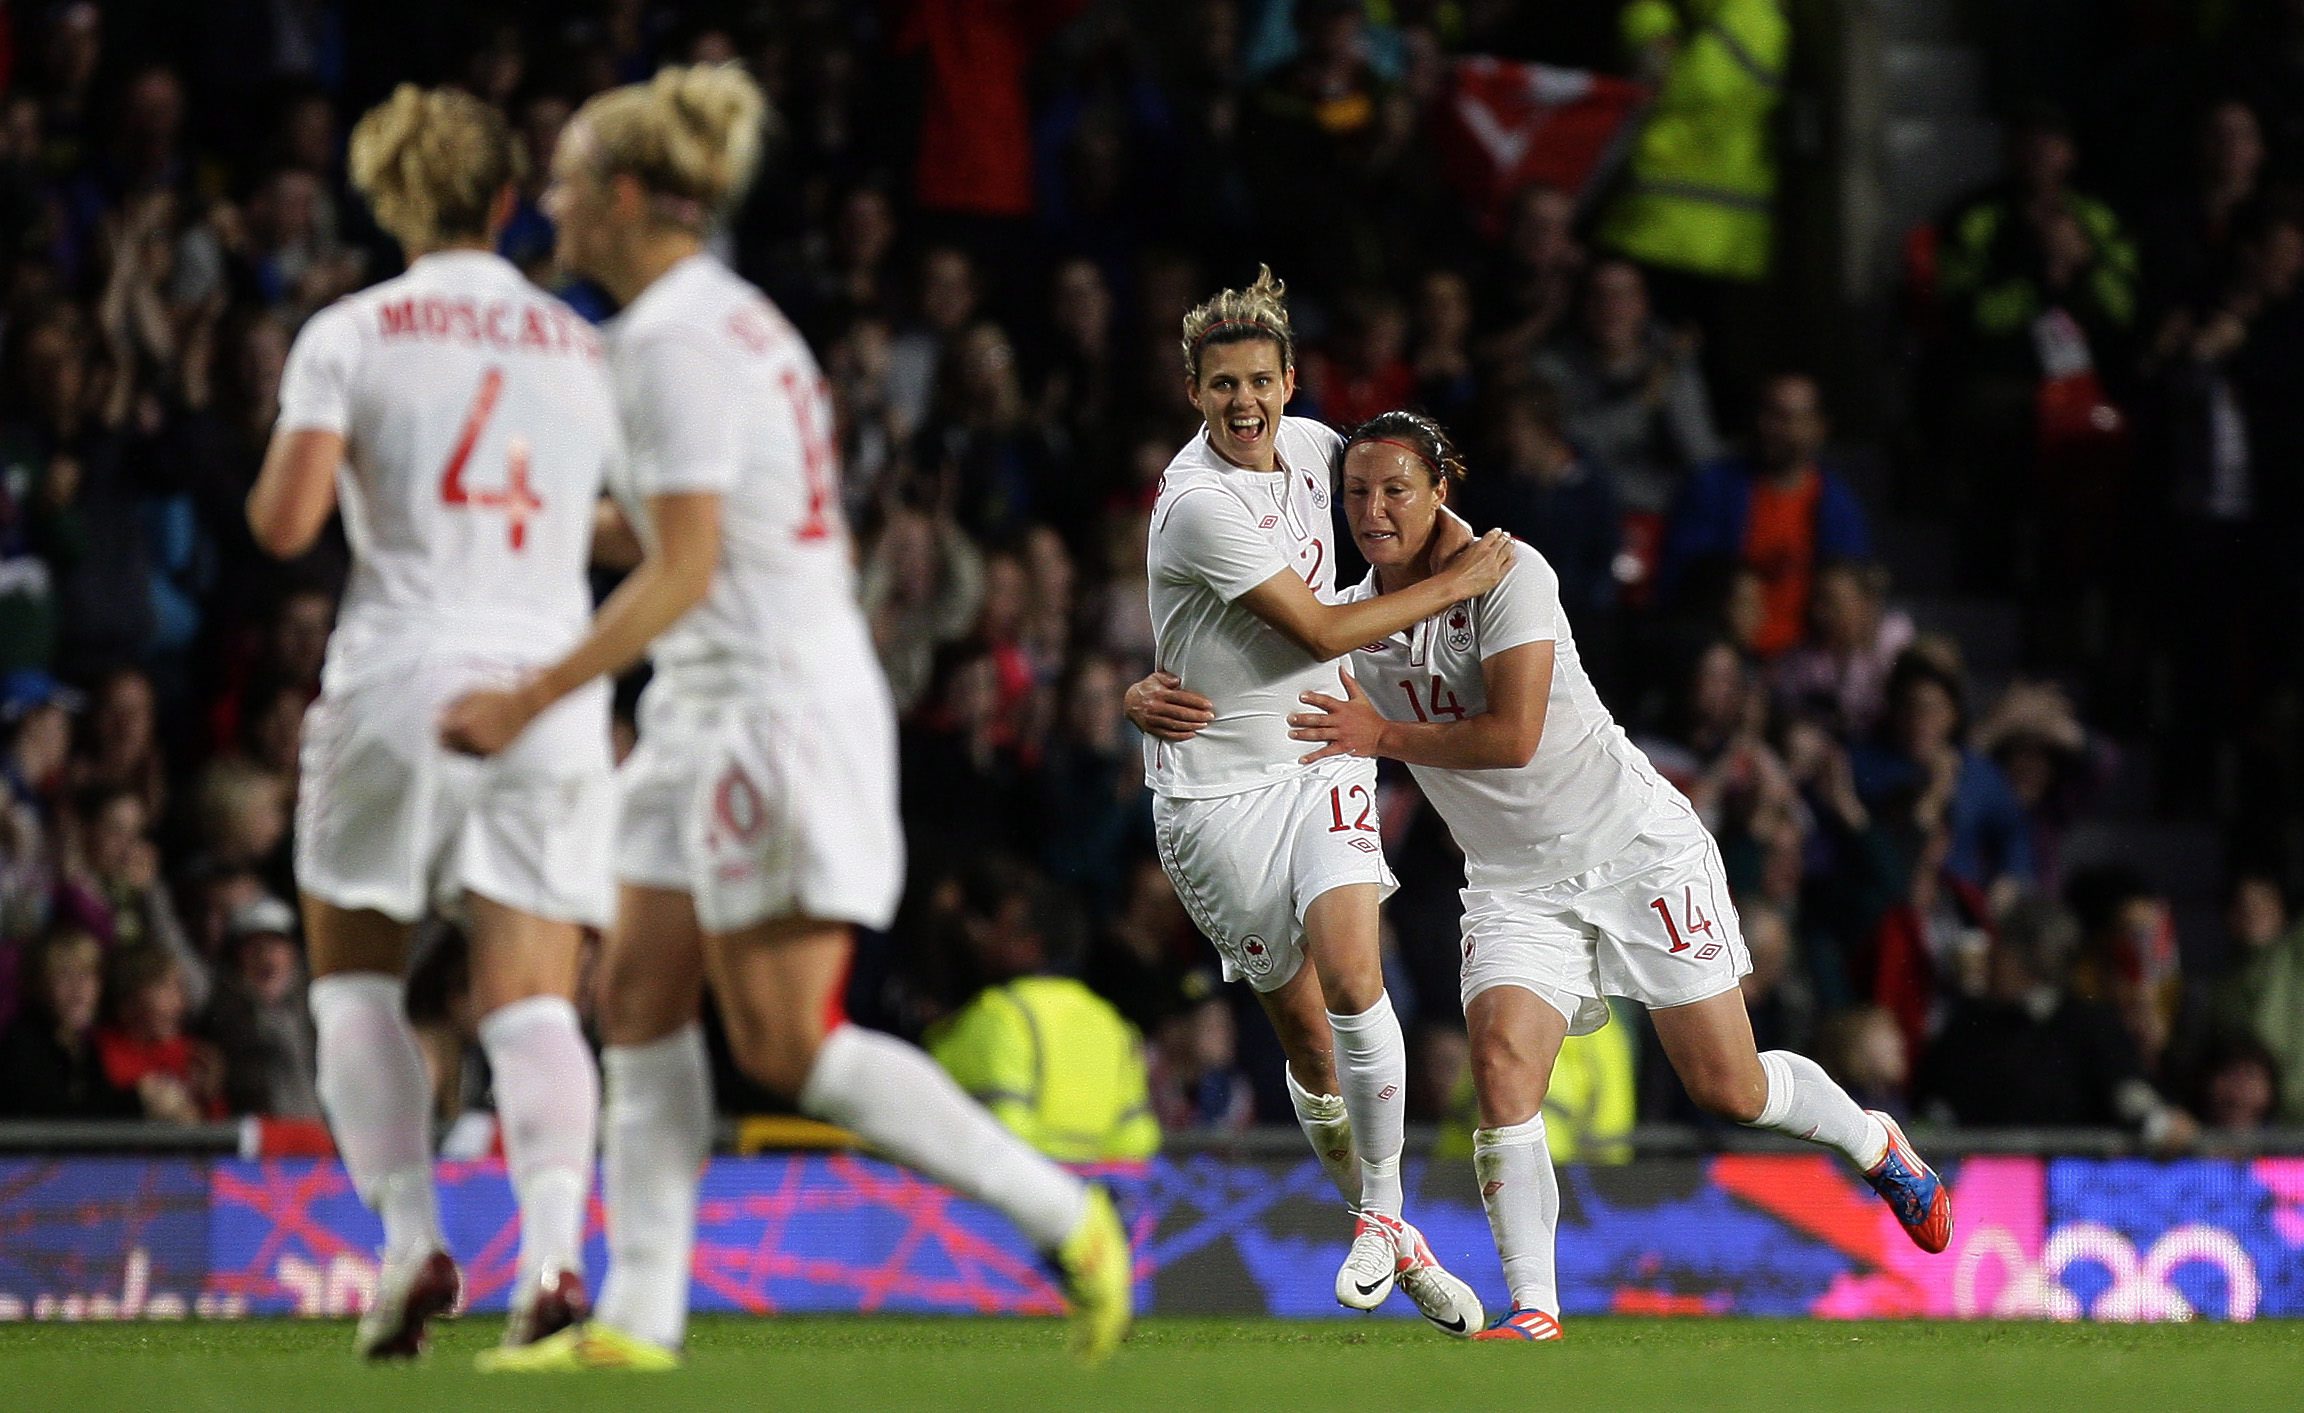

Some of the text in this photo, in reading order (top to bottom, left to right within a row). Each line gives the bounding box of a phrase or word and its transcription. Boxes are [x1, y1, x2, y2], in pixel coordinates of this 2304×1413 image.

[442, 367, 542, 552] 4
[1399, 675, 1465, 722] 14
[1328, 785, 1378, 833] 12
[1650, 885, 1714, 954] 14
